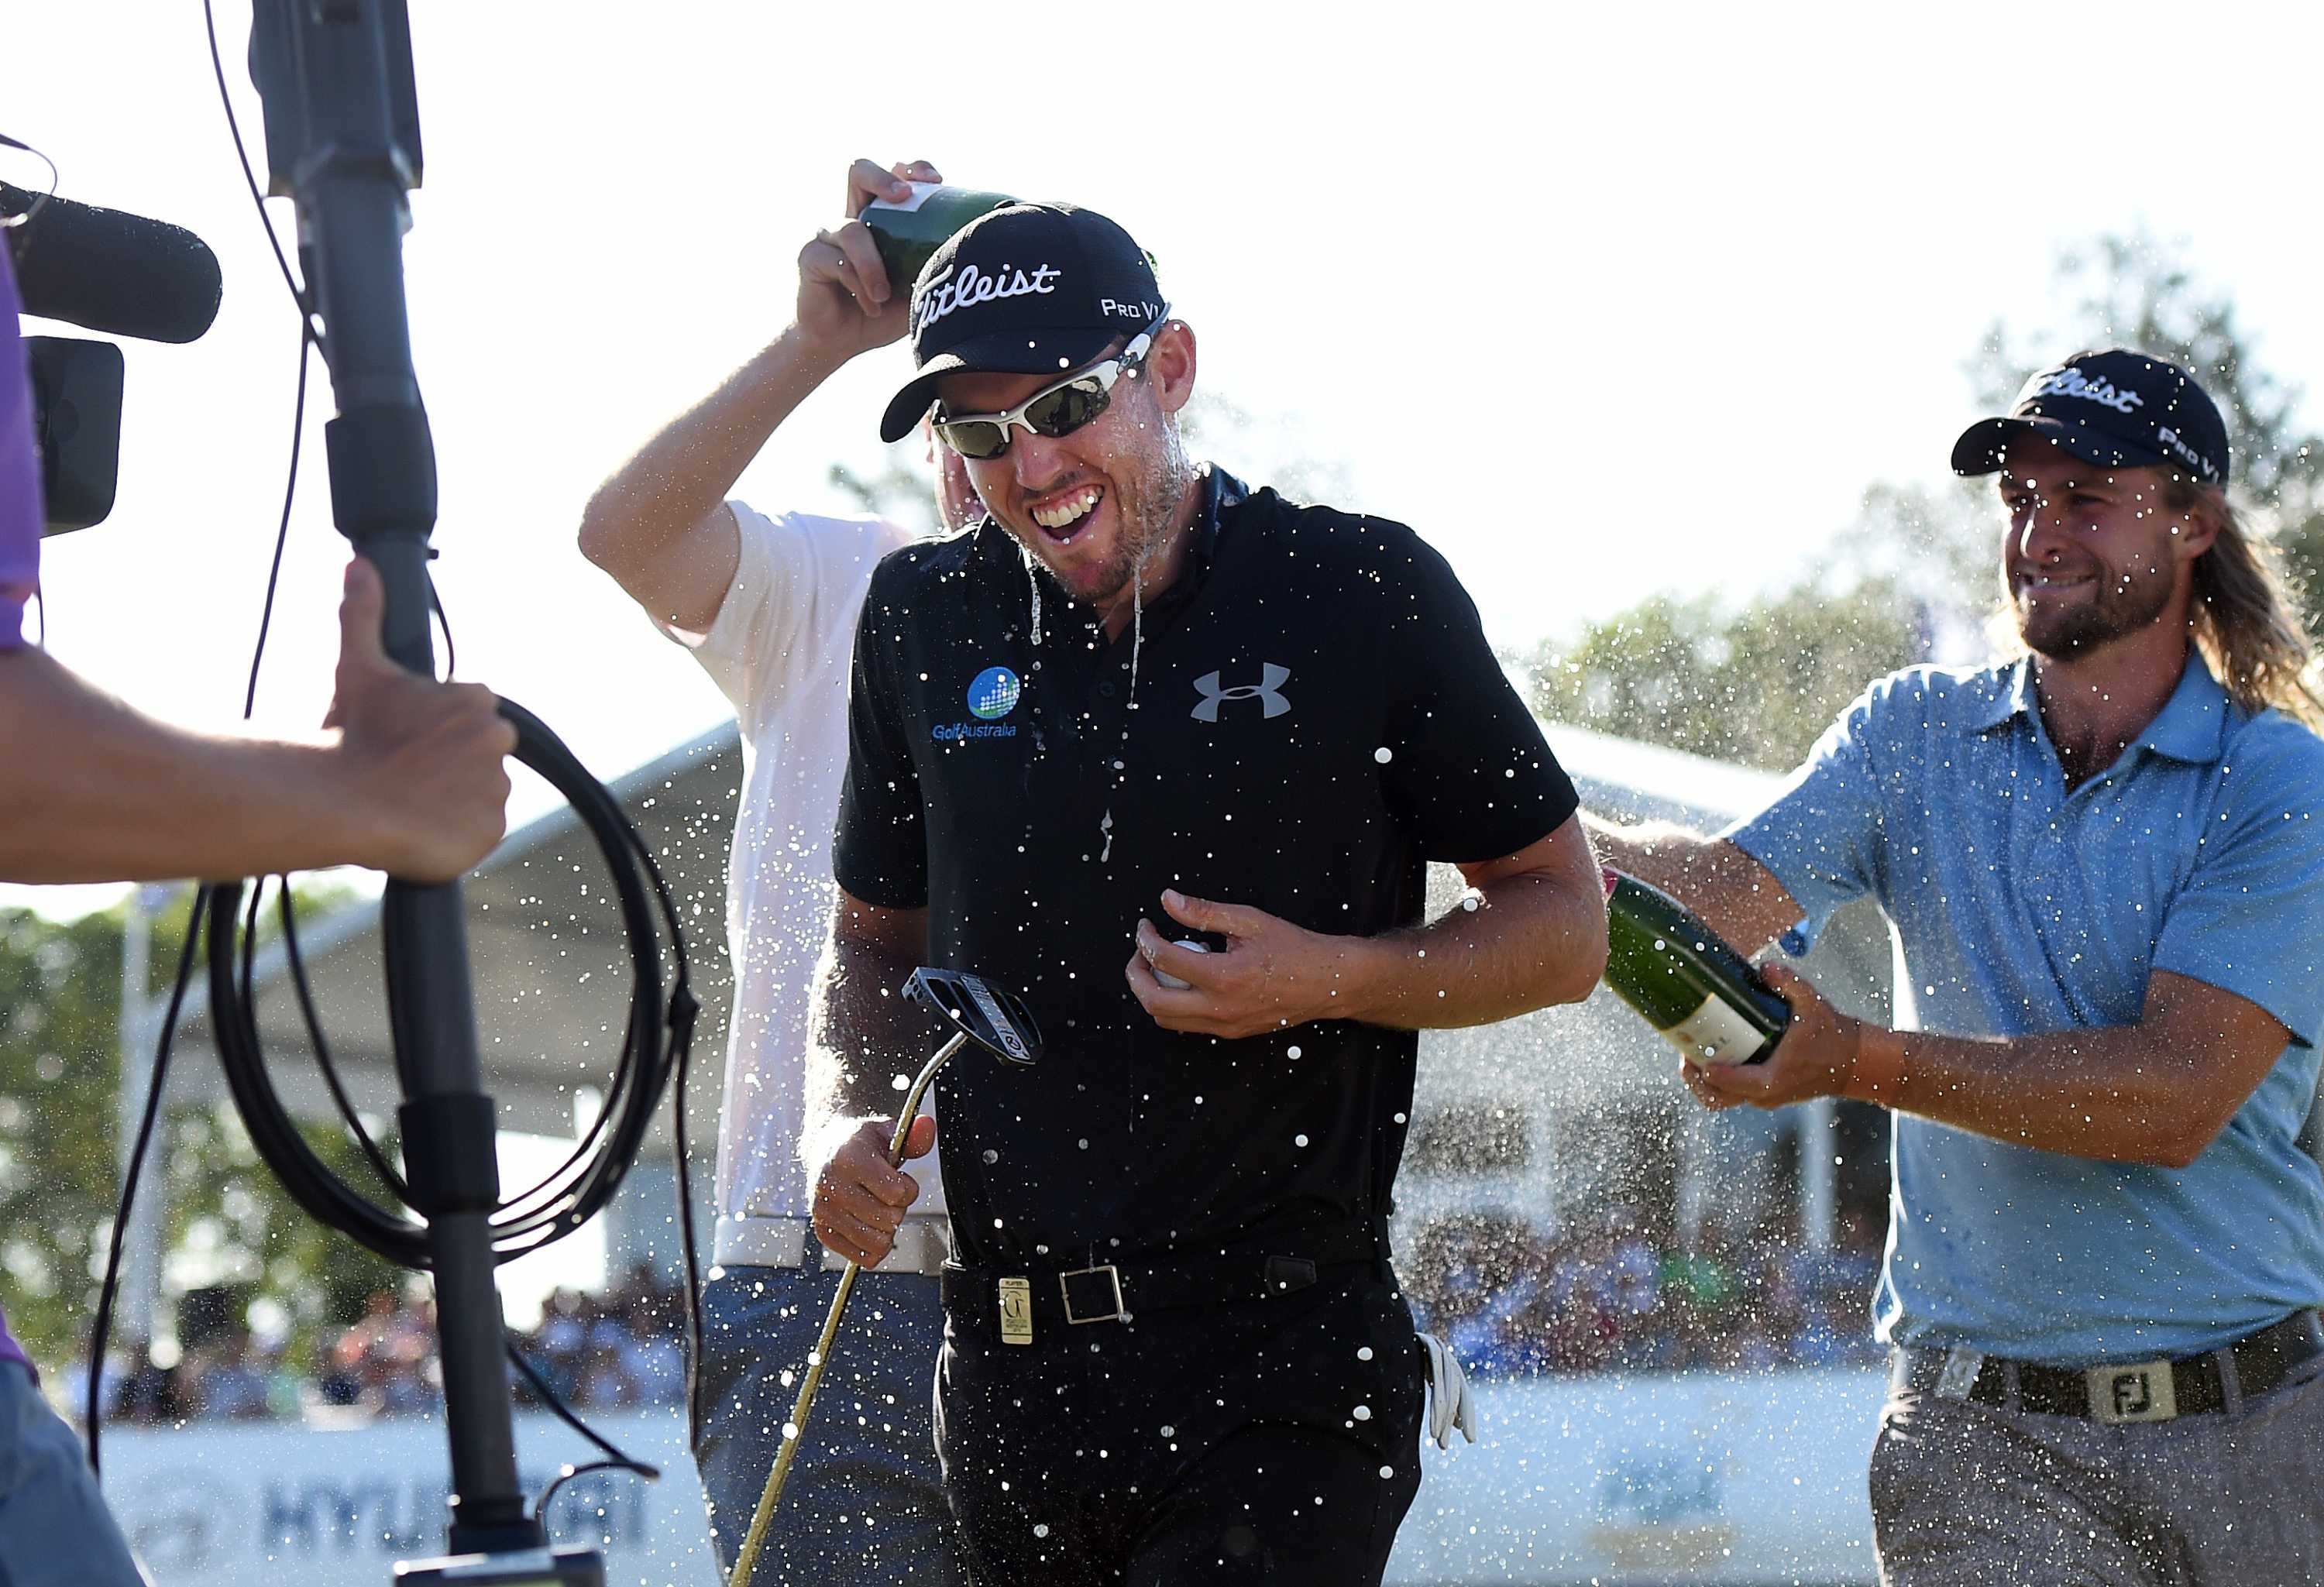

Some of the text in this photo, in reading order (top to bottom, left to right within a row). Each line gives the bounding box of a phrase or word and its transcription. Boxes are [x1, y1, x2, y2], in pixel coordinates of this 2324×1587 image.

[914, 264, 1061, 328] Titleist
[2036, 368, 2144, 413] leist
[261, 1475, 646, 1550] HYUAI
